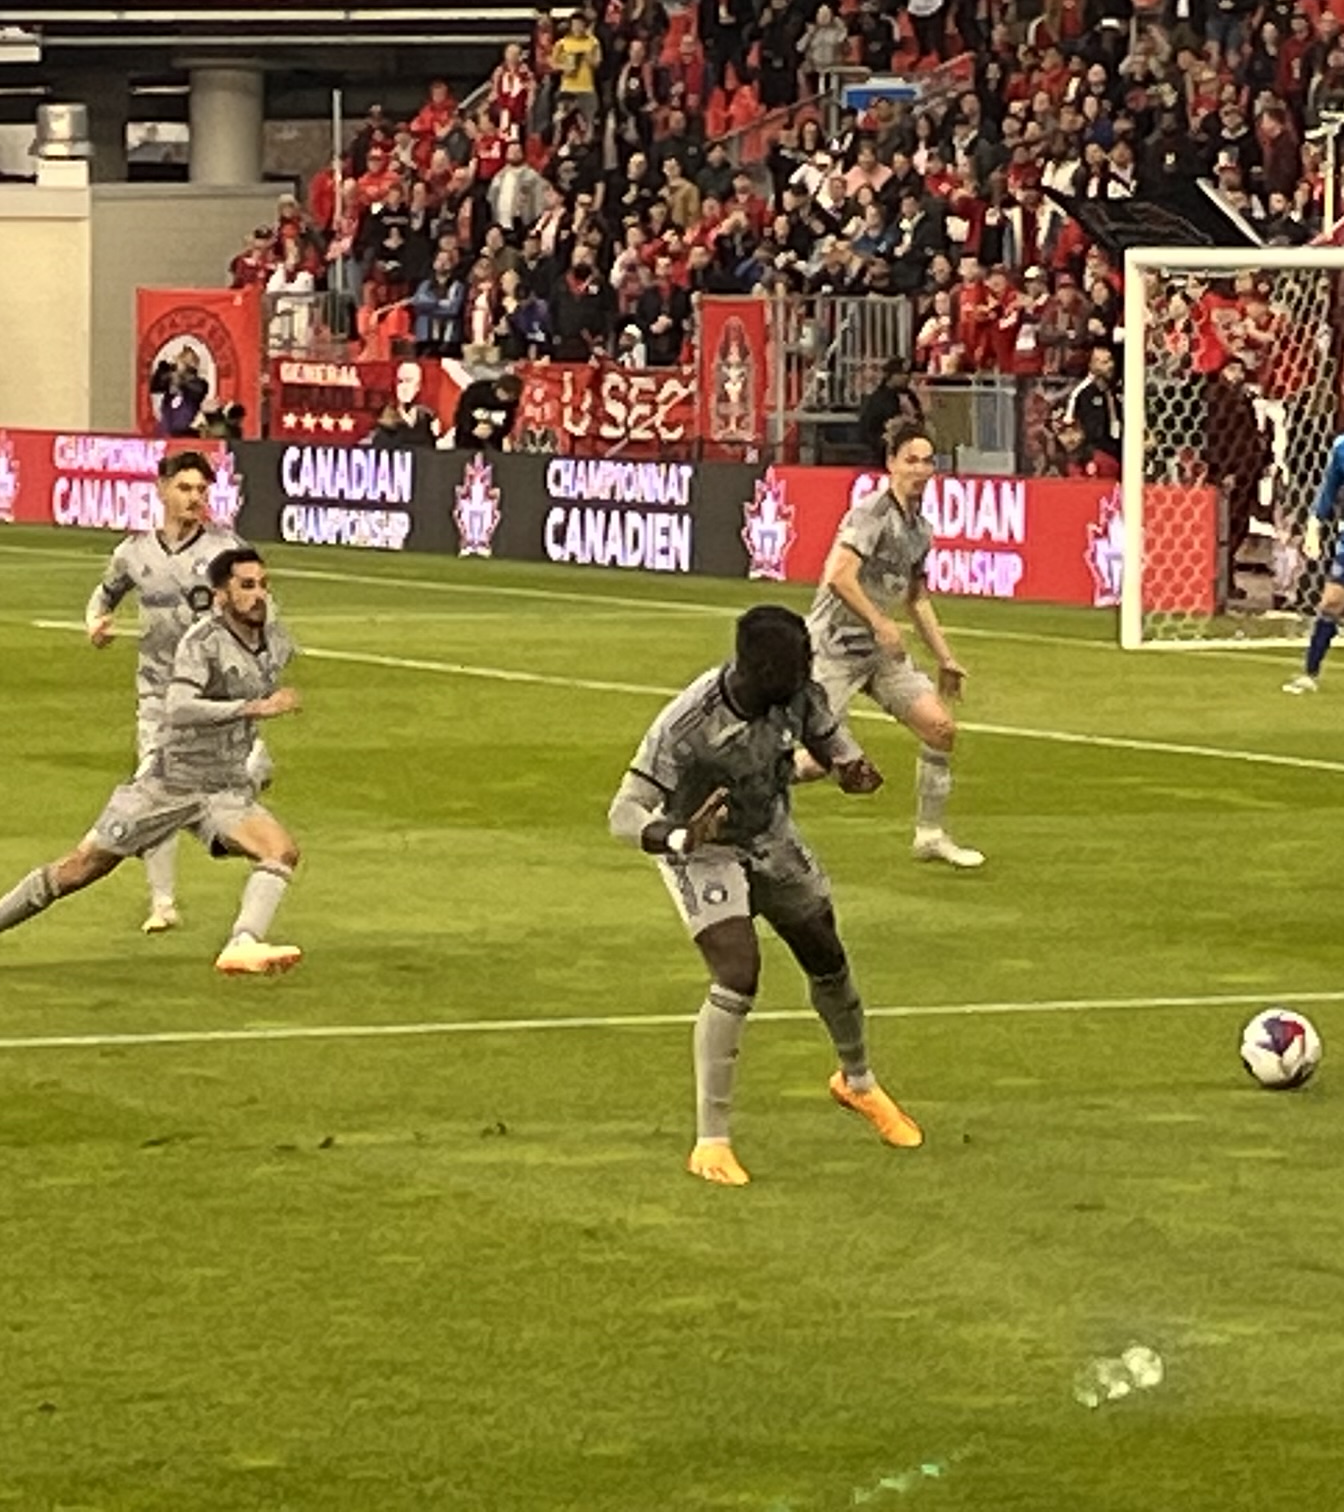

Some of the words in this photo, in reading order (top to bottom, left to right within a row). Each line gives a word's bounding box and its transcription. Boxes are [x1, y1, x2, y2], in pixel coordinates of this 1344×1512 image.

[282, 445, 411, 503] CANADIAN
[546, 459, 694, 506] CHAMPIONNAT
[282, 504, 411, 550] CHAMPIONSHIP
[544, 507, 692, 572] CANADIEN
